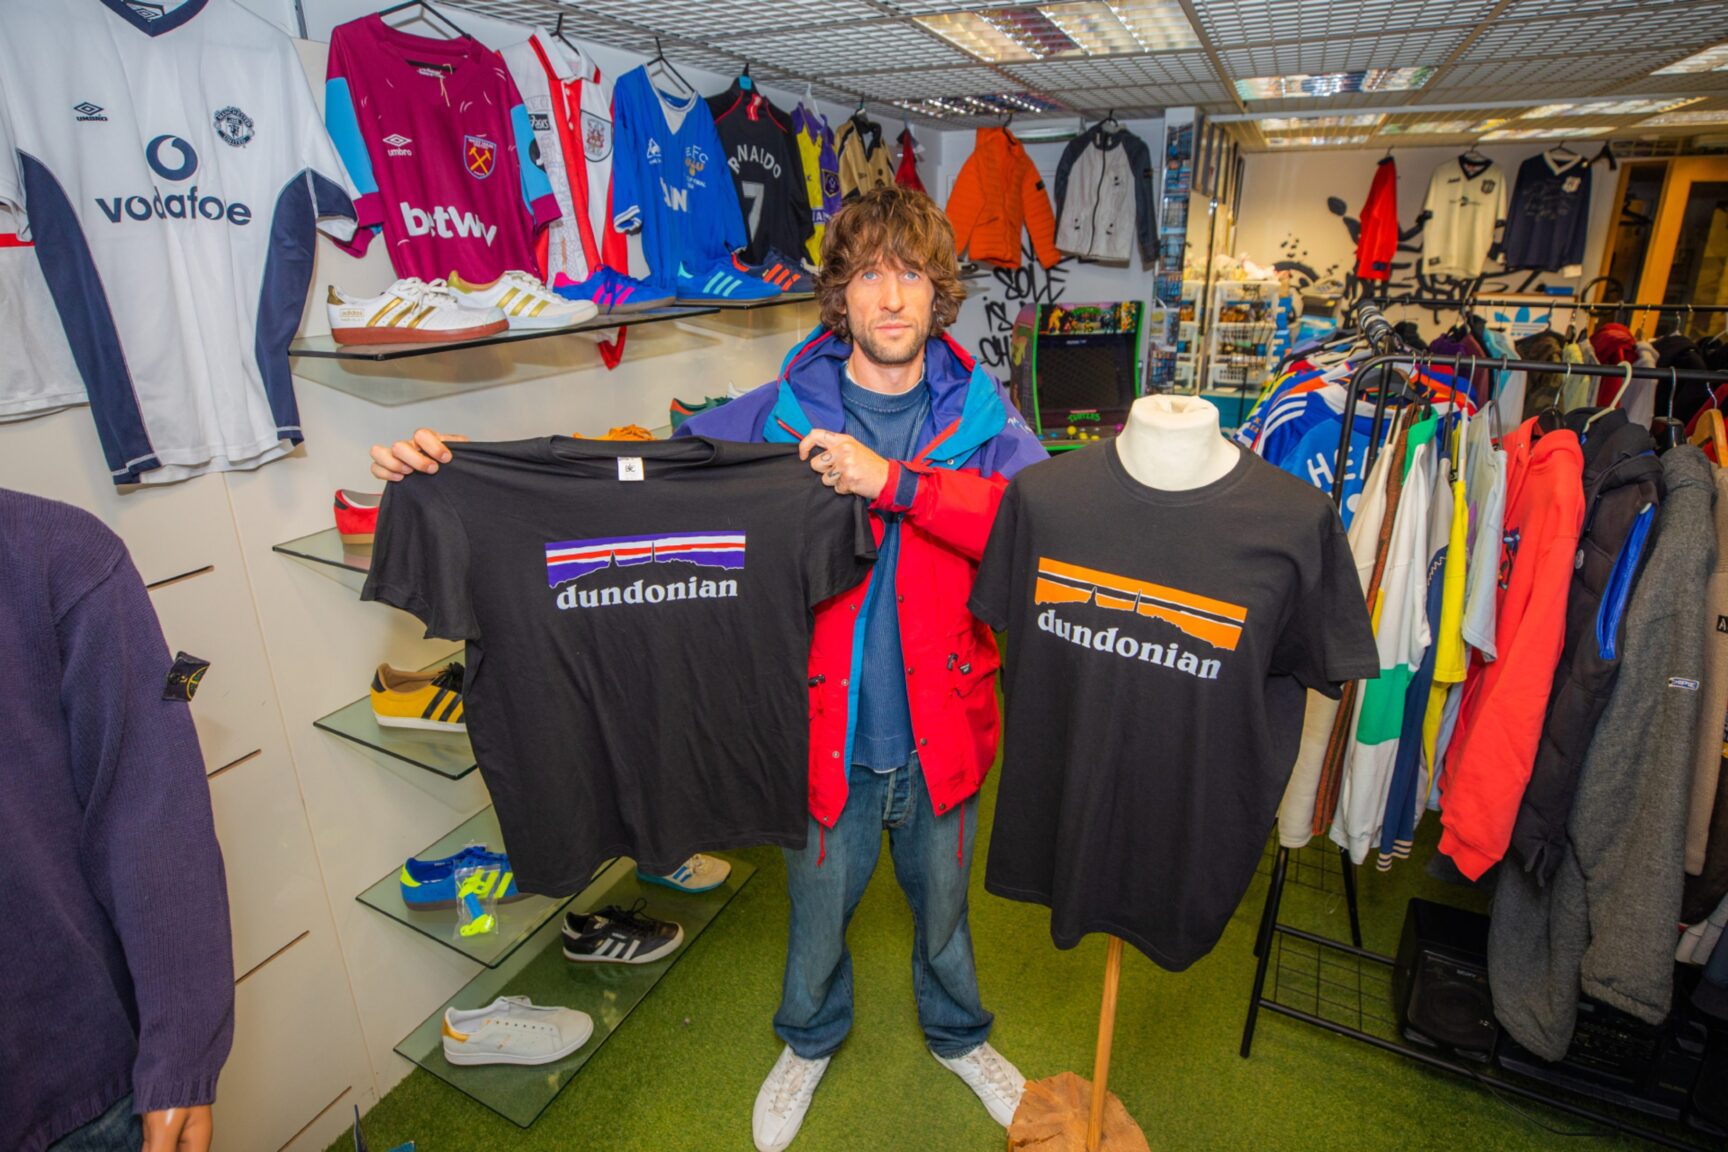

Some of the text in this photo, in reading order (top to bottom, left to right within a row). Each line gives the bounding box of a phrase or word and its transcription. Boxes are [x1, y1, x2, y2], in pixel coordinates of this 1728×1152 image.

[387, 148, 413, 157] umbro
[727, 144, 782, 179] RNALDO
[95, 185, 252, 226] vodafoe
[741, 180, 765, 243] 7
[993, 262, 1070, 304] SOLE
[557, 576, 738, 610] dundonian
[1037, 609, 1222, 680] dundonian
